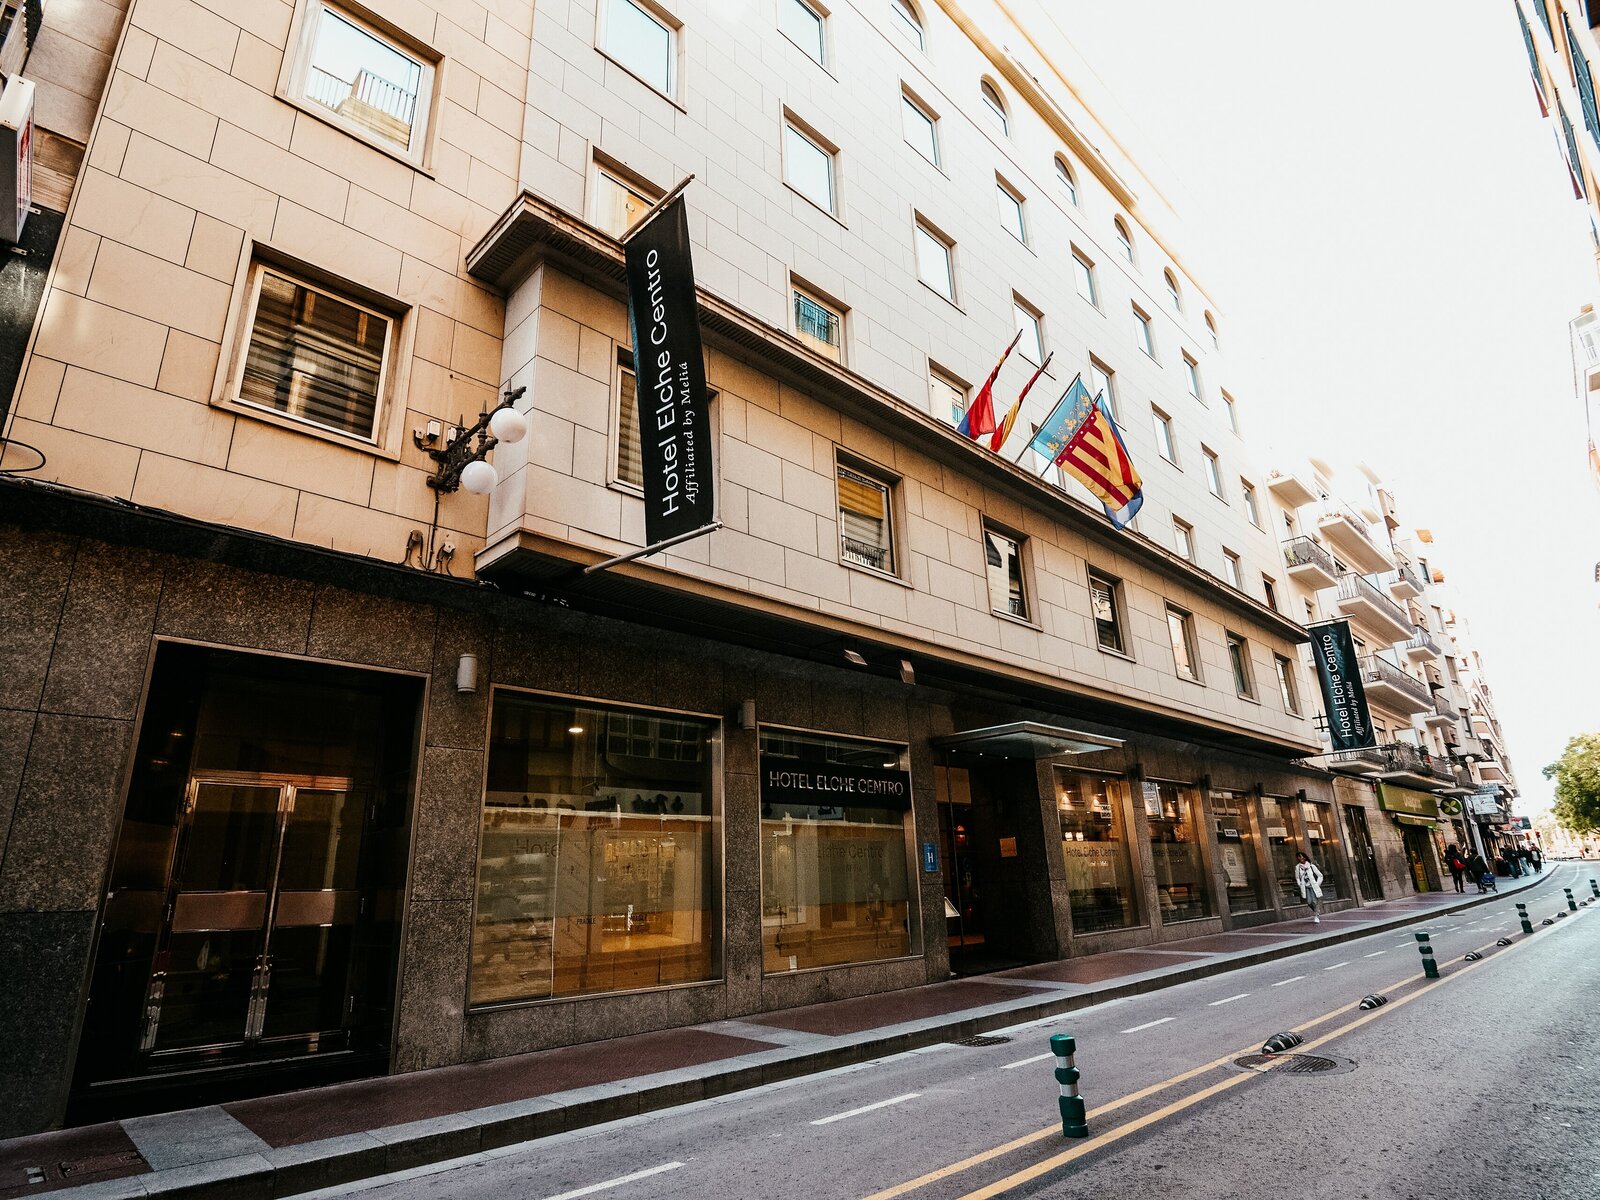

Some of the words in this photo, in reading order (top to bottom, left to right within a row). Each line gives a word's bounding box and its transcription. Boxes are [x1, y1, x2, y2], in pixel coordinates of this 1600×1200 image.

[646, 249, 667, 345] Centro
[653, 350, 676, 431] Elche
[678, 361, 691, 405] Meliá
[682, 410, 696, 426] by
[658, 435, 679, 517] Hotel
[683, 430, 699, 505] Affiliated
[1322, 634, 1338, 673] Centro
[1331, 674, 1346, 705] Elche
[1335, 707, 1353, 738] Hotel
[769, 770, 814, 790] HOTEL
[816, 775, 856, 793] ELCHE
[857, 778, 904, 796] CENTRO
[514, 838, 562, 858] Hote
[927, 851, 934, 864] H
